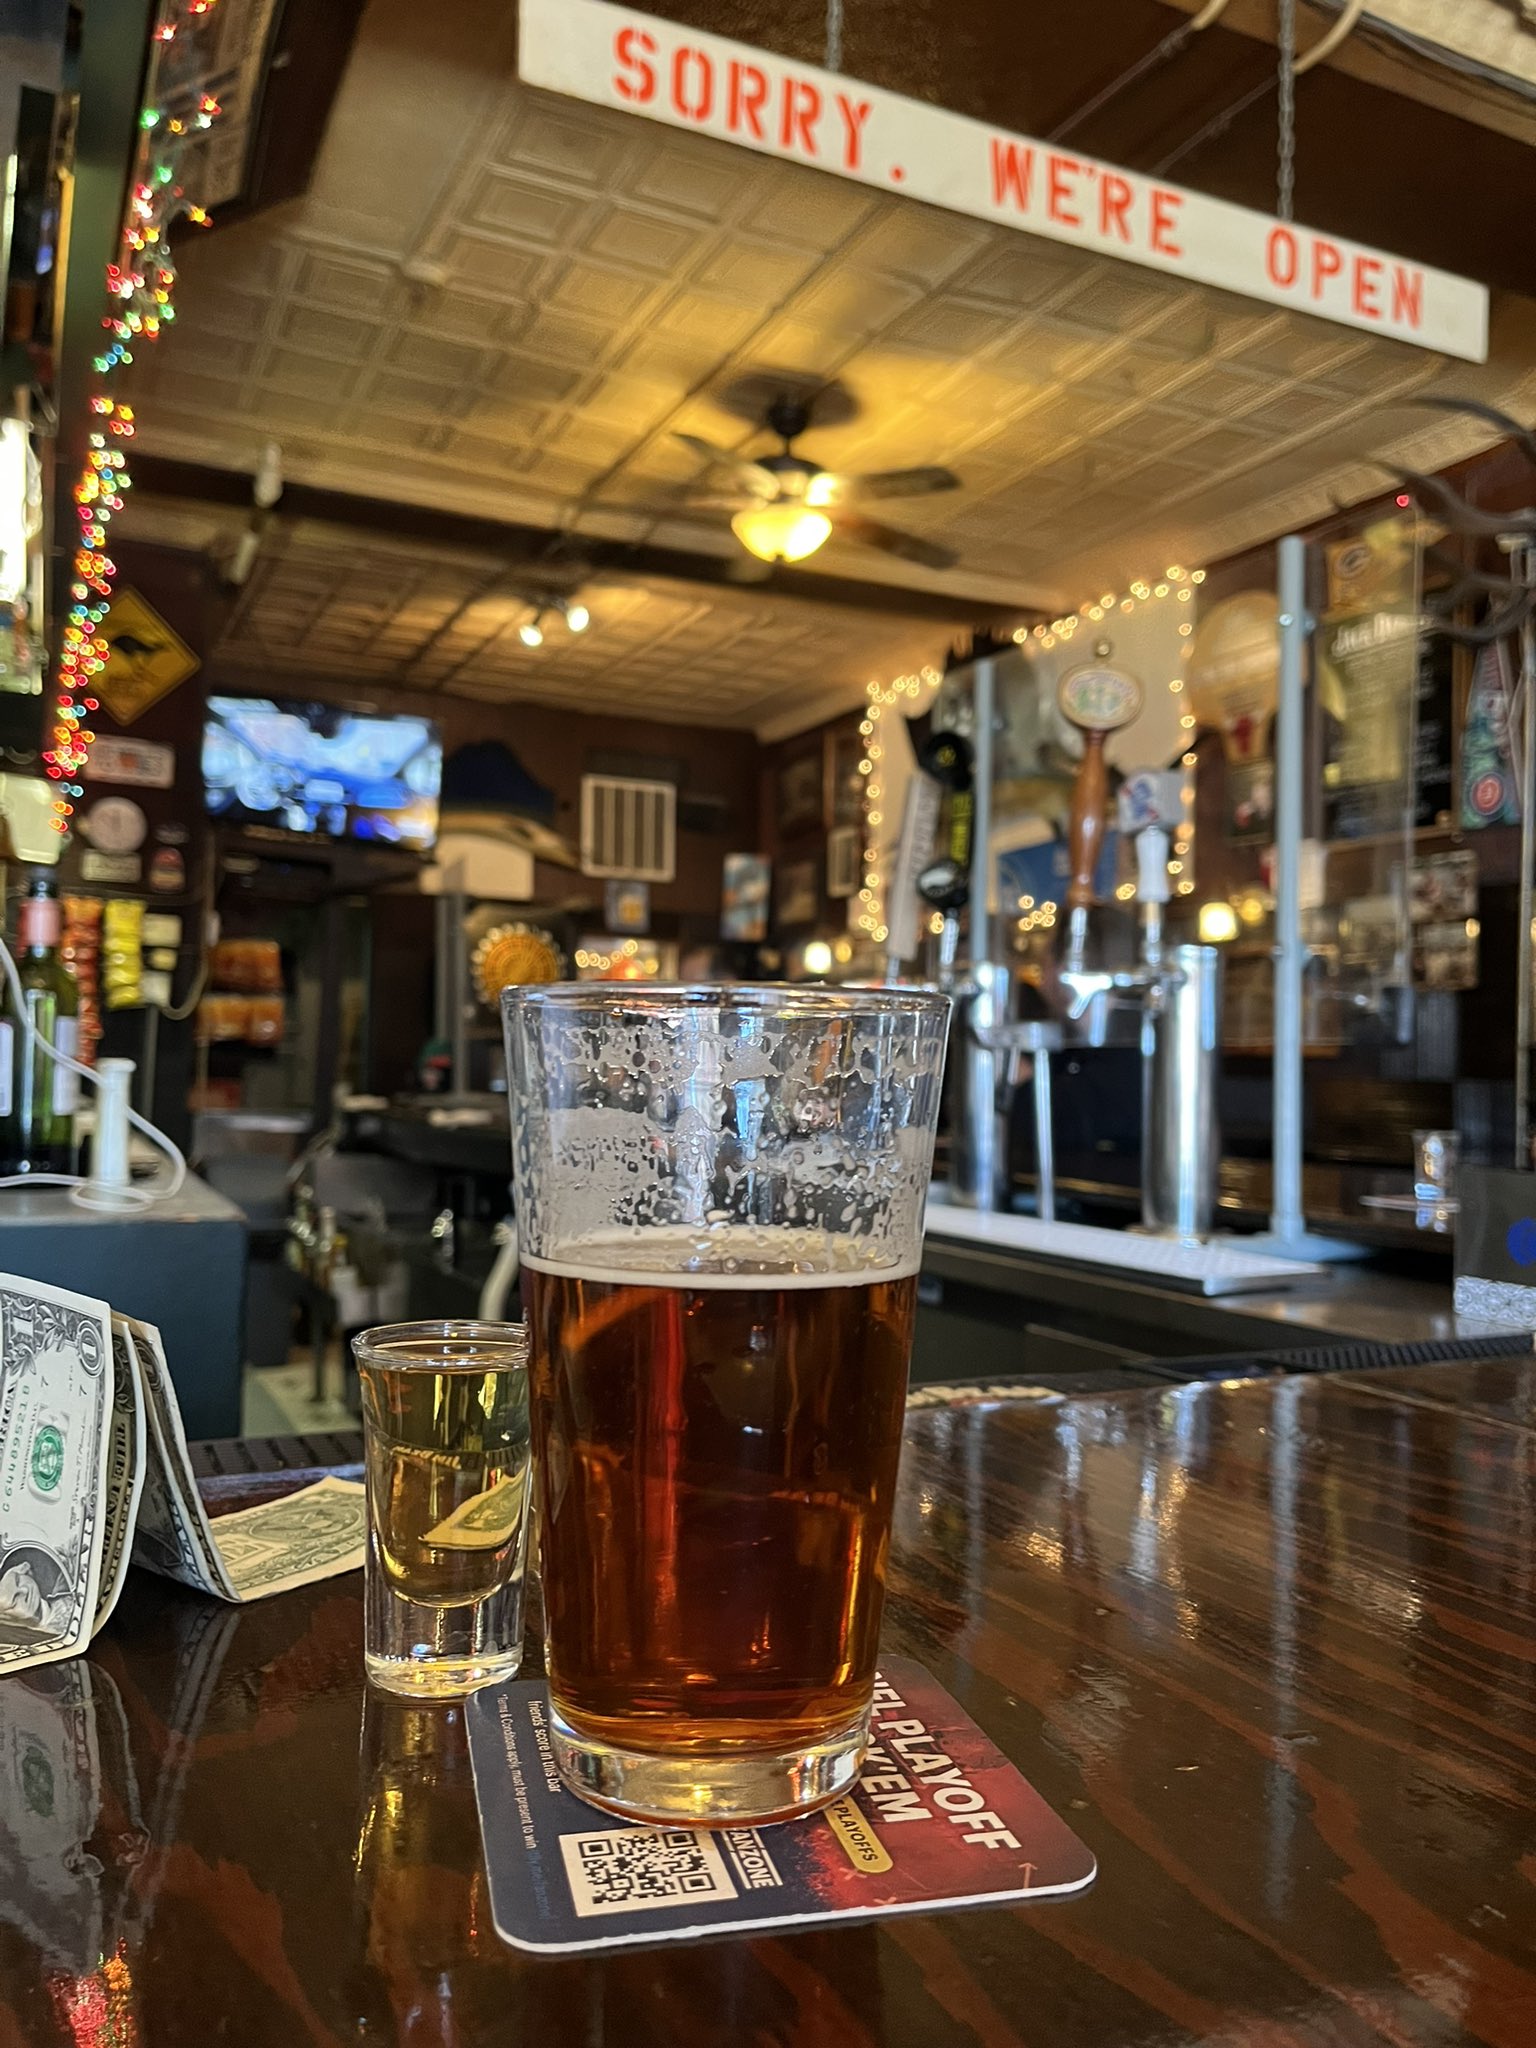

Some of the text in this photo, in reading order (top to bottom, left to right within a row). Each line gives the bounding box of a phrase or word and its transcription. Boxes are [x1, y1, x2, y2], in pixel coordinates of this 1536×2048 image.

[614, 26, 1423, 328] SORRY. WE'RE OPEN
[527, 1700, 547, 1727] friends'
[501, 1718, 518, 1751] Conditions
[534, 1728, 551, 1751] score
[540, 1751, 555, 1760] in
[512, 1769, 526, 1786] must
[547, 1776, 562, 1793] bar
[877, 1719, 1022, 1849] PLAYOFF
[515, 1786, 529, 1797] be
[514, 1796, 534, 1825] present
[522, 1824, 536, 1834] to
[524, 1834, 540, 1849] win
[834, 1806, 878, 1862] PLAYOFFS
[729, 1829, 775, 1889] ANZONE
